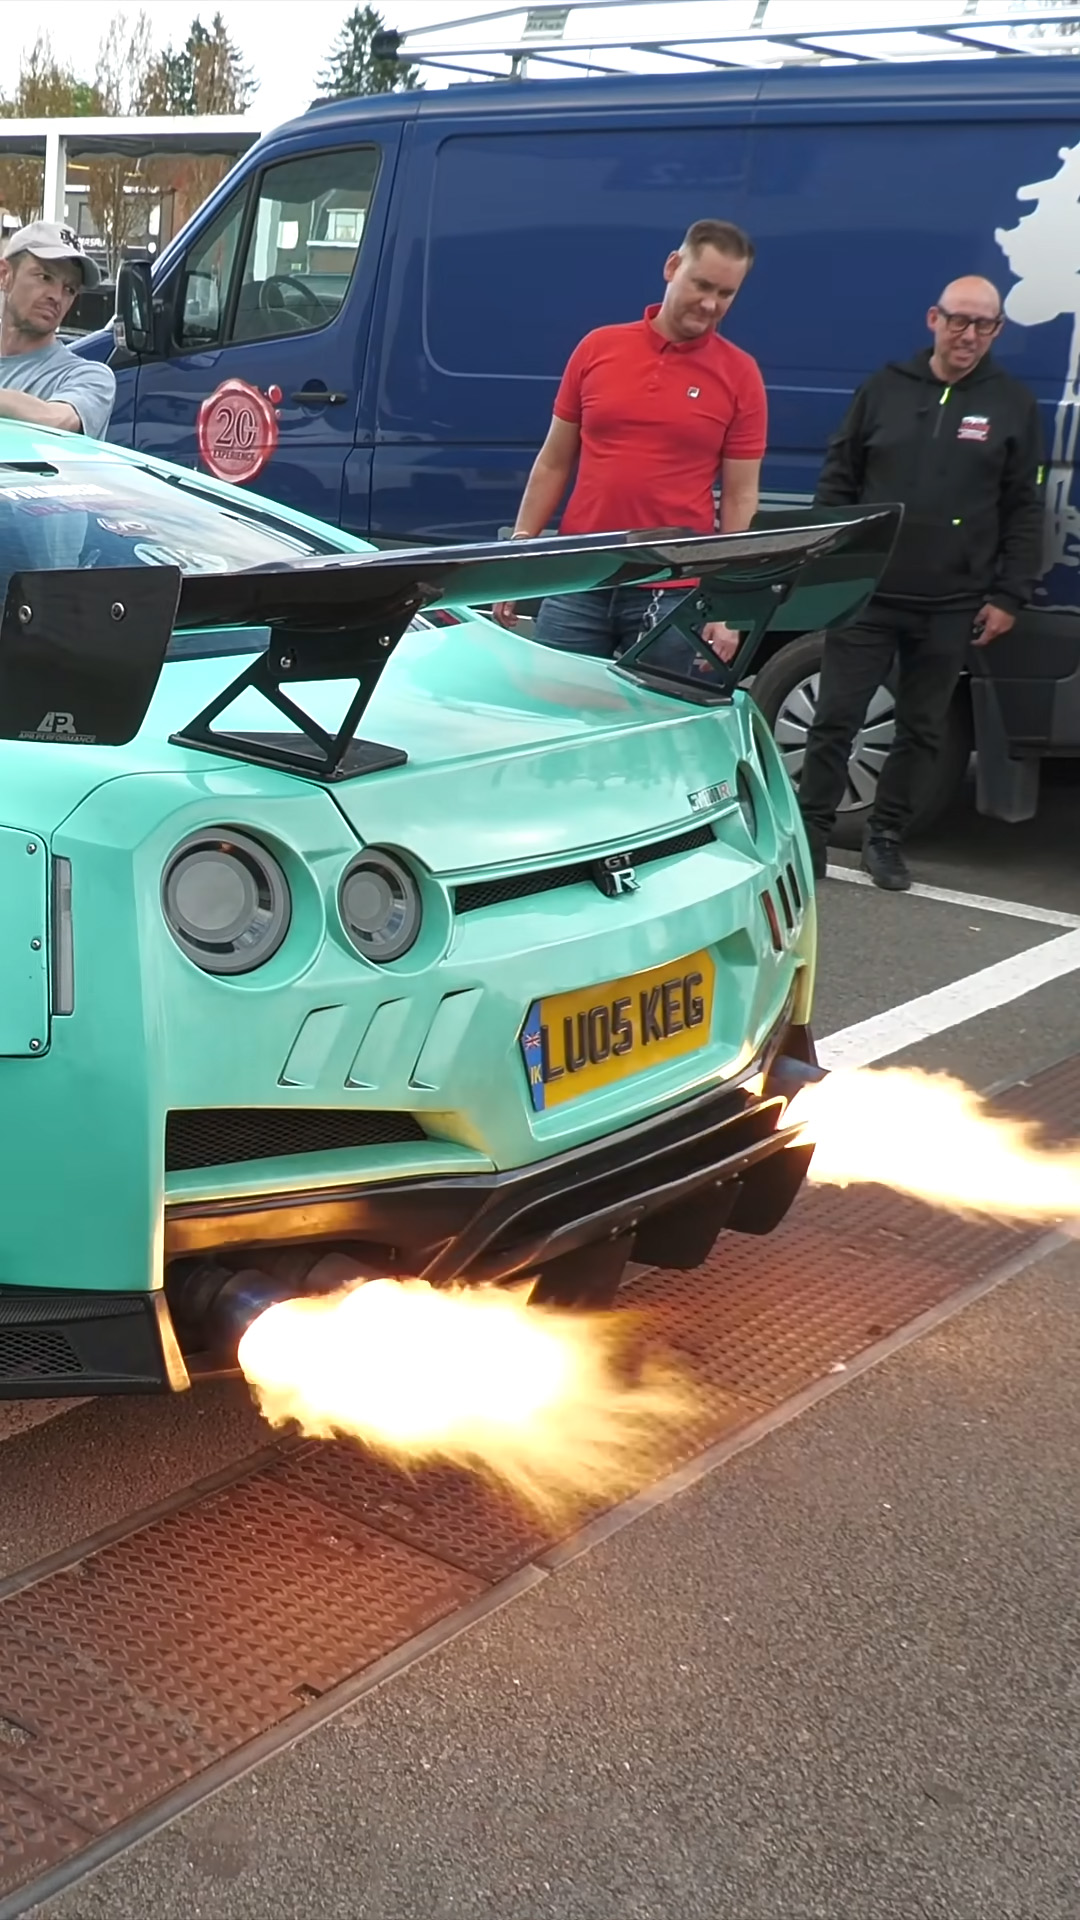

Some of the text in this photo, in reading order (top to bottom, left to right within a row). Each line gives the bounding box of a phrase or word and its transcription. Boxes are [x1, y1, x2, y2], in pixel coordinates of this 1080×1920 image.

[604, 852, 632, 869] GT
[611, 868, 641, 893] R
[541, 971, 704, 1084] LU05 KEG
